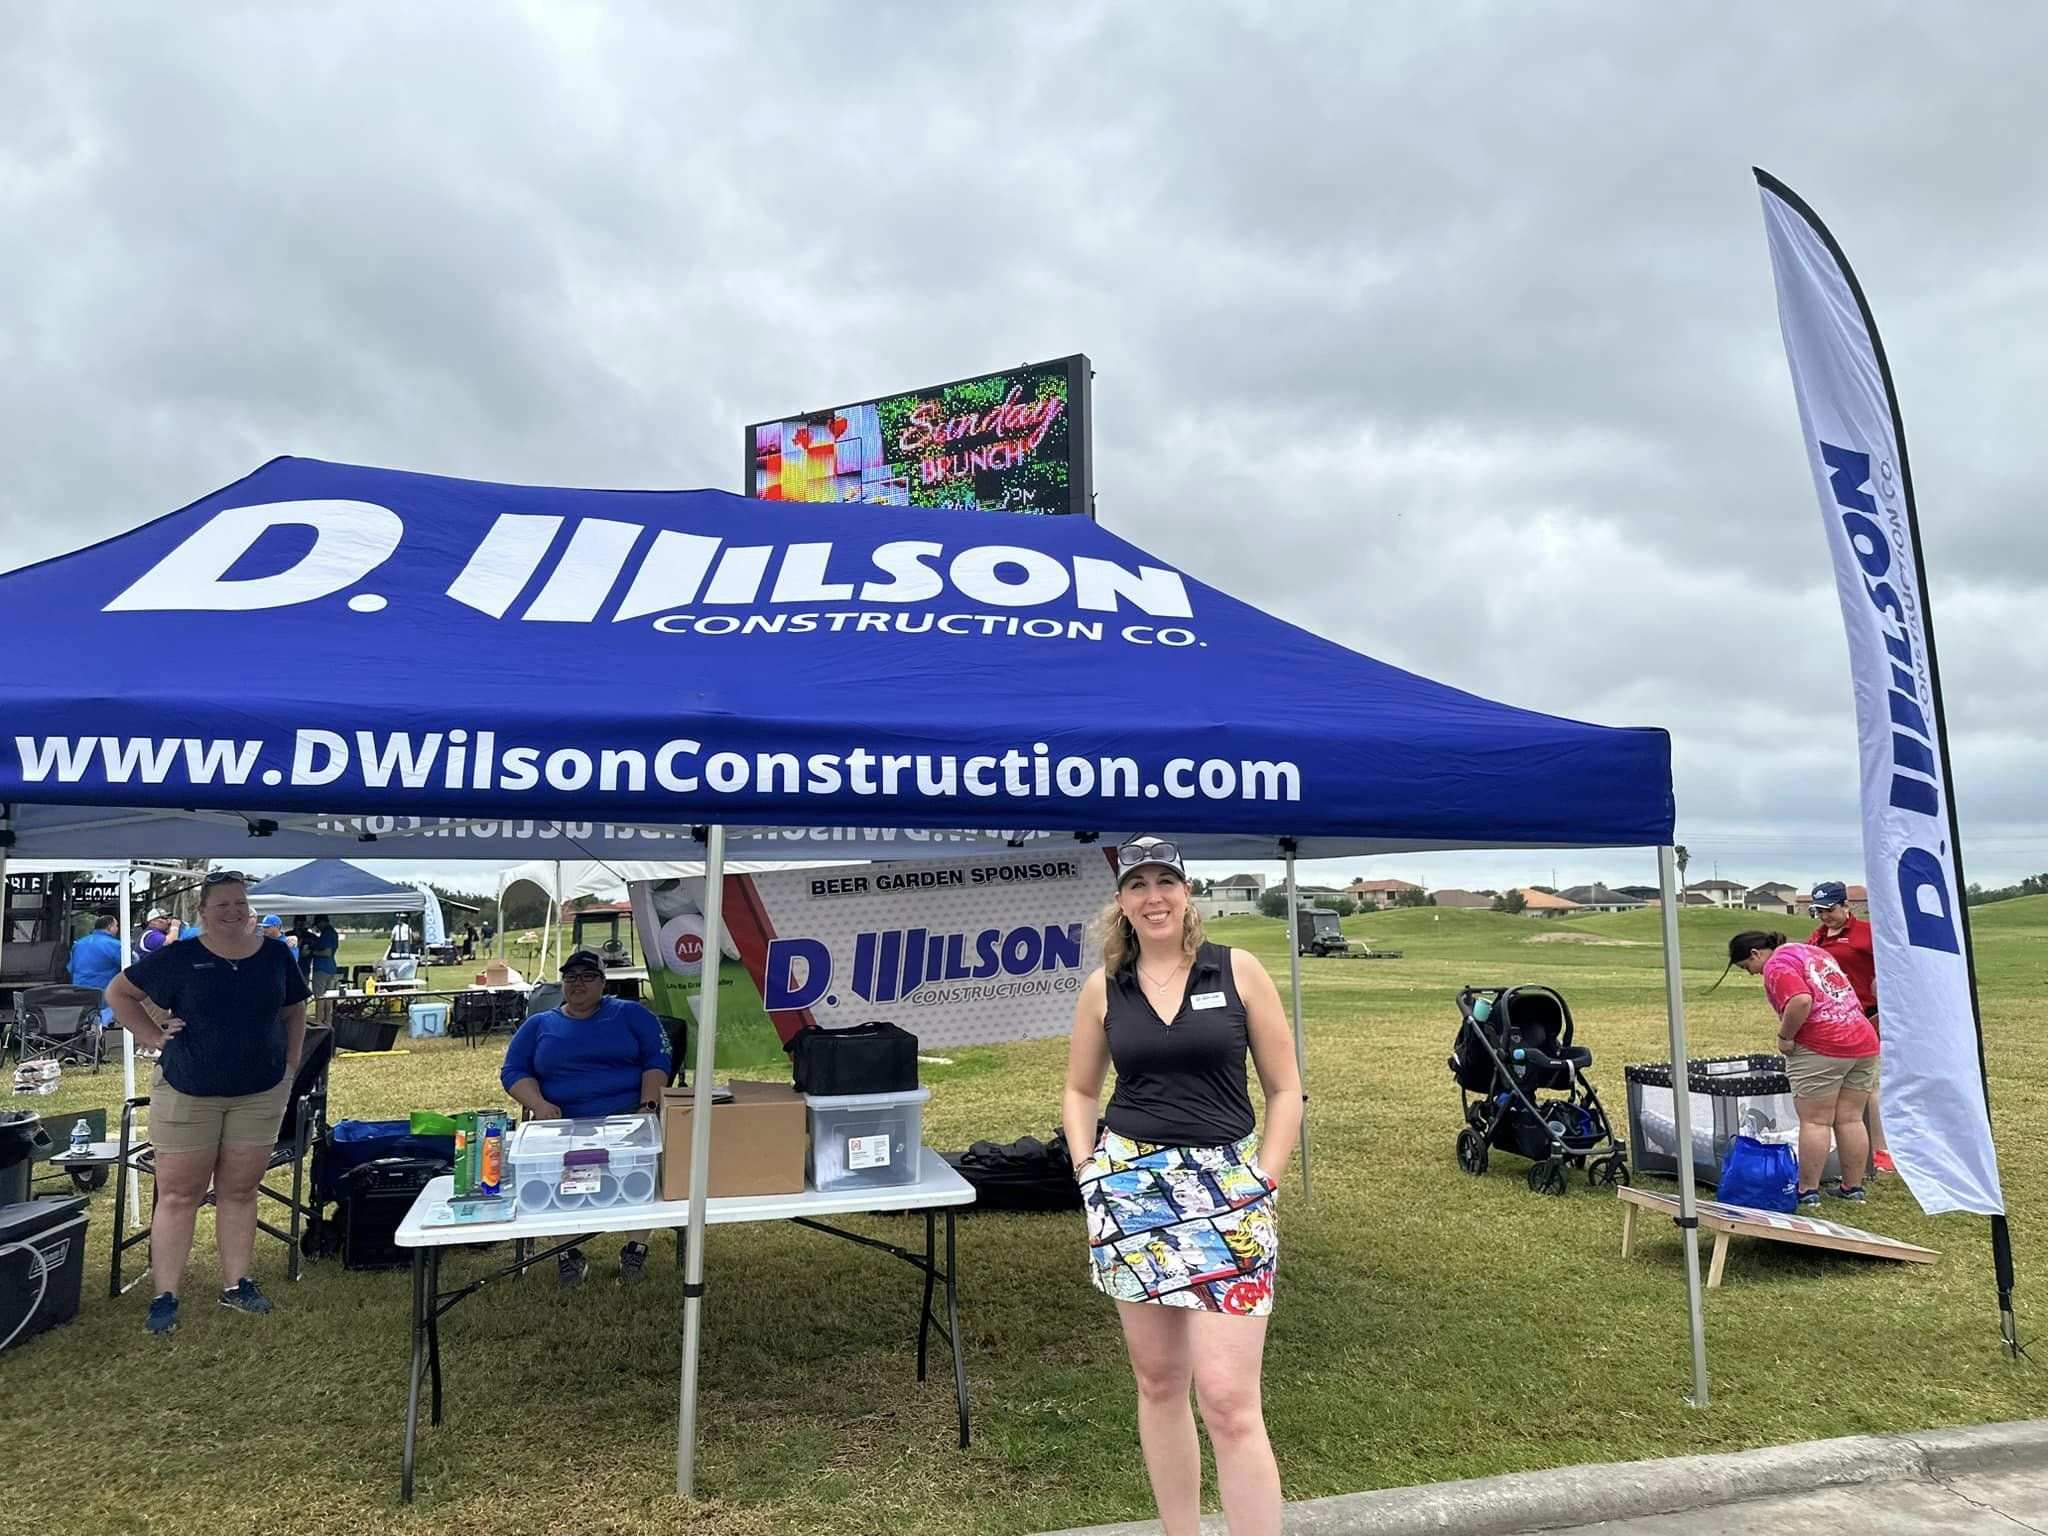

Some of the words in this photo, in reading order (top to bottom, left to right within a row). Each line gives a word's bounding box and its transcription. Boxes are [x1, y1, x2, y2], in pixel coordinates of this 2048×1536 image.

[900, 383, 1063, 452] Sunday
[921, 445, 1025, 485] BRUNCH
[100, 498, 404, 613] D.
[445, 513, 1194, 622] WILSON
[652, 611, 1103, 641] CONSTRUCTION
[1121, 625, 1208, 647] CO.
[1819, 439, 1939, 818] WILSON
[15, 728, 1302, 802] www.DWilsonConstruction.com
[811, 877, 869, 896] BEER
[876, 870, 964, 891] GARDEN
[971, 861, 1077, 884] SPONSOR:
[764, 937, 839, 1012] D.
[851, 923, 1085, 1002] WILSON
[911, 979, 1052, 1006] CONSTRUCTION
[1053, 976, 1081, 991] CO.
